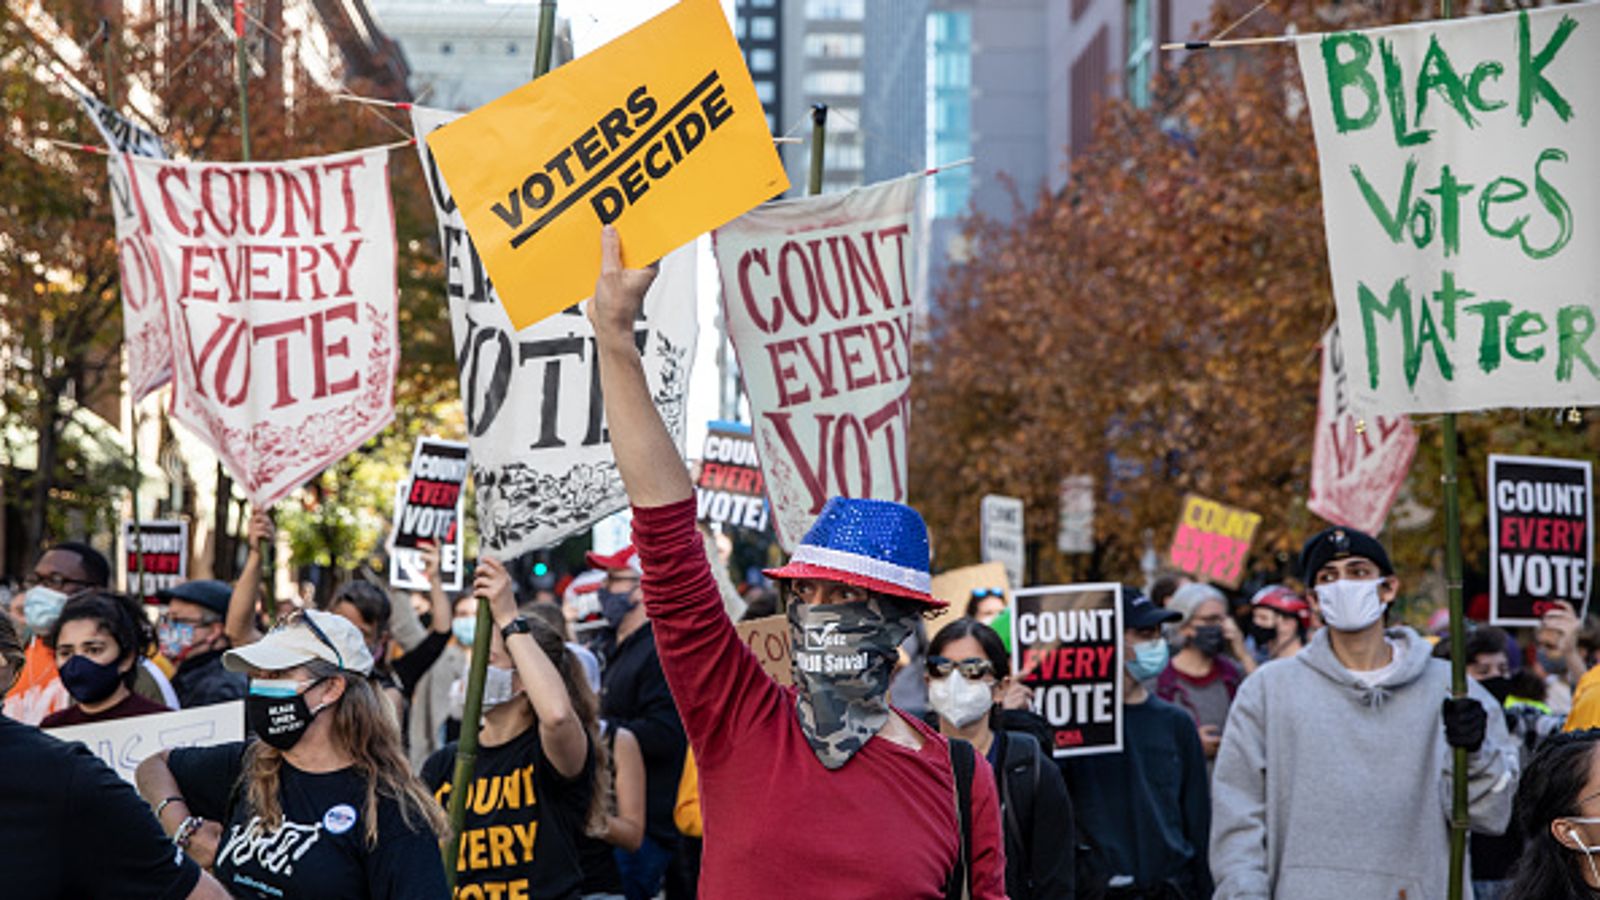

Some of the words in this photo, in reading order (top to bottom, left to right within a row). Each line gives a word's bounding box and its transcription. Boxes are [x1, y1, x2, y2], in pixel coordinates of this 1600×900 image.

[490, 86, 658, 230] VOTERS
[589, 83, 734, 225] DECIDE
[157, 156, 365, 238] COUNT
[179, 239, 363, 303] EVERY
[737, 224, 911, 334] COUNT
[177, 302, 360, 410] VOTE
[704, 435, 761, 468] COUN
[762, 393, 908, 515] VOT
[1497, 479, 1585, 516] COUNT
[1500, 516, 1585, 553] EVERY
[1499, 554, 1585, 600] VOTE
[1018, 607, 1114, 645] COUNT
[1022, 645, 1114, 682] EVERY
